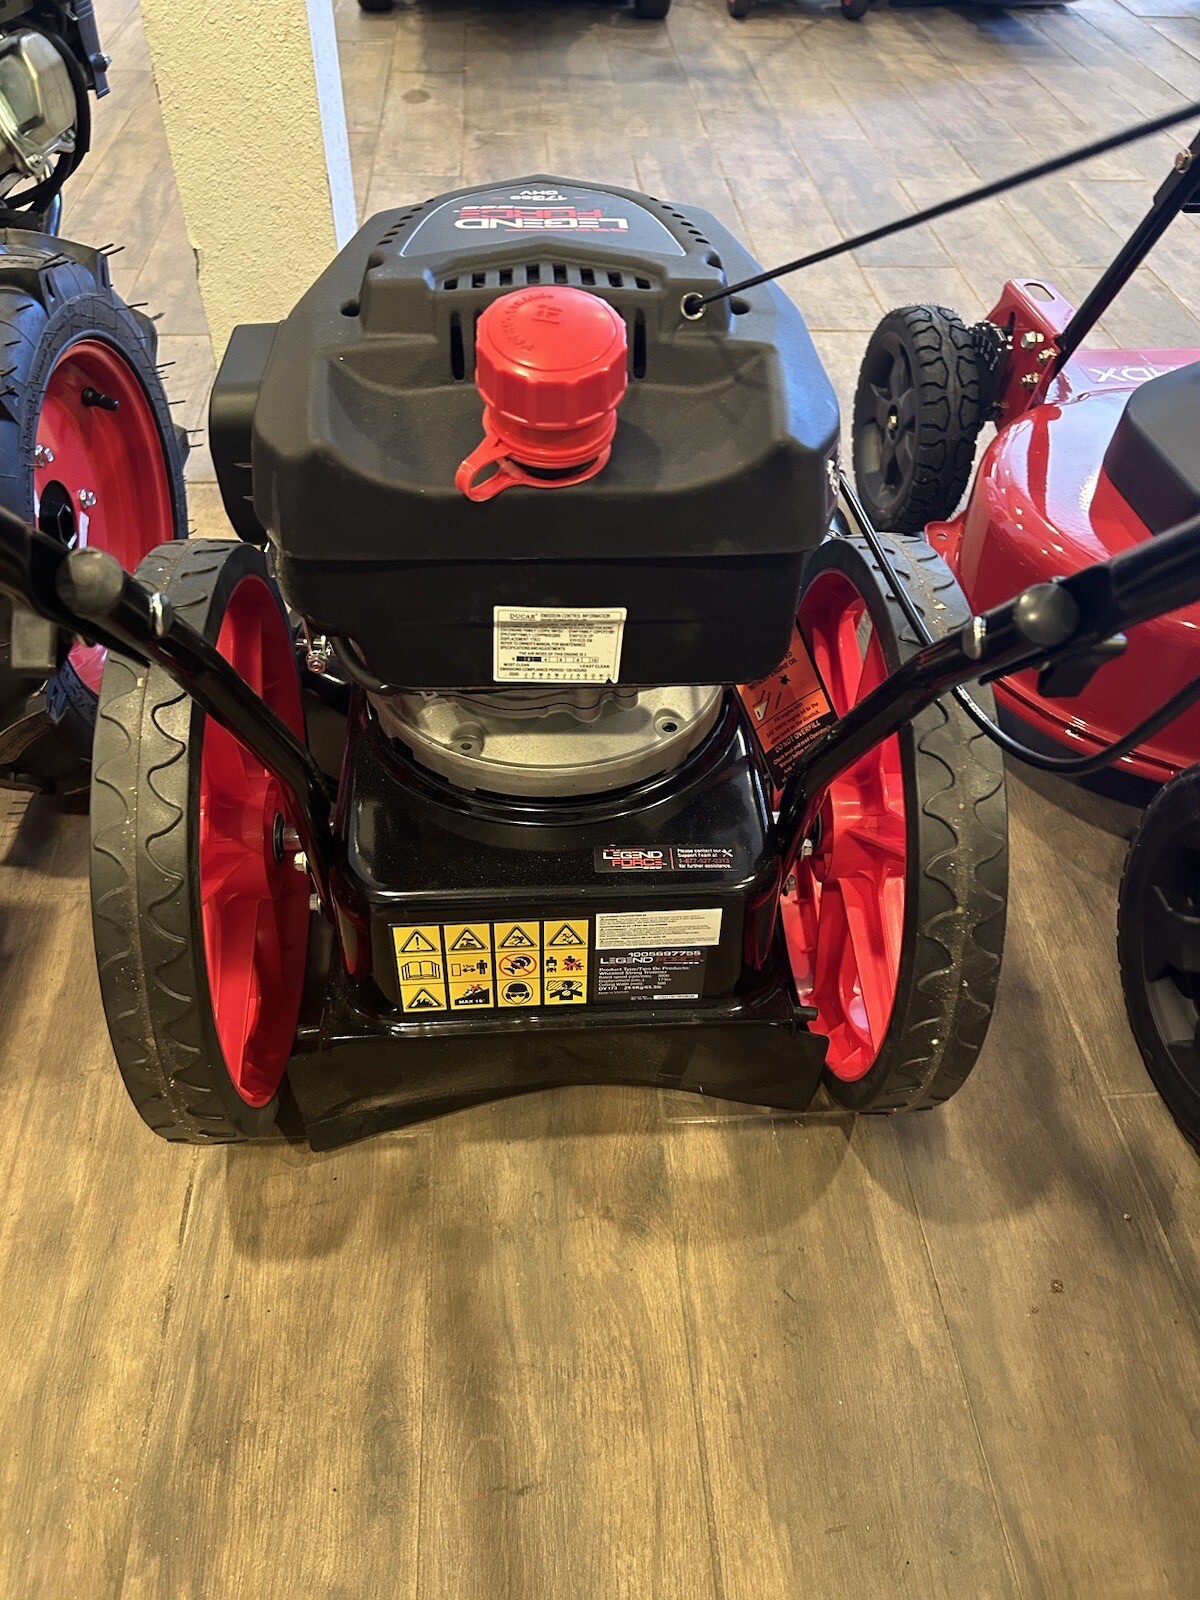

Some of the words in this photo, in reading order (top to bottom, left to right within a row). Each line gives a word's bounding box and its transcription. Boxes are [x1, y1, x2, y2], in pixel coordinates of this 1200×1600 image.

[460, 208, 603, 218] FORCE
[454, 218, 628, 230] LEGEND
[794, 720, 821, 739] OVERFILL
[602, 851, 663, 859] LEGEND
[600, 956, 654, 964] LEGEND
